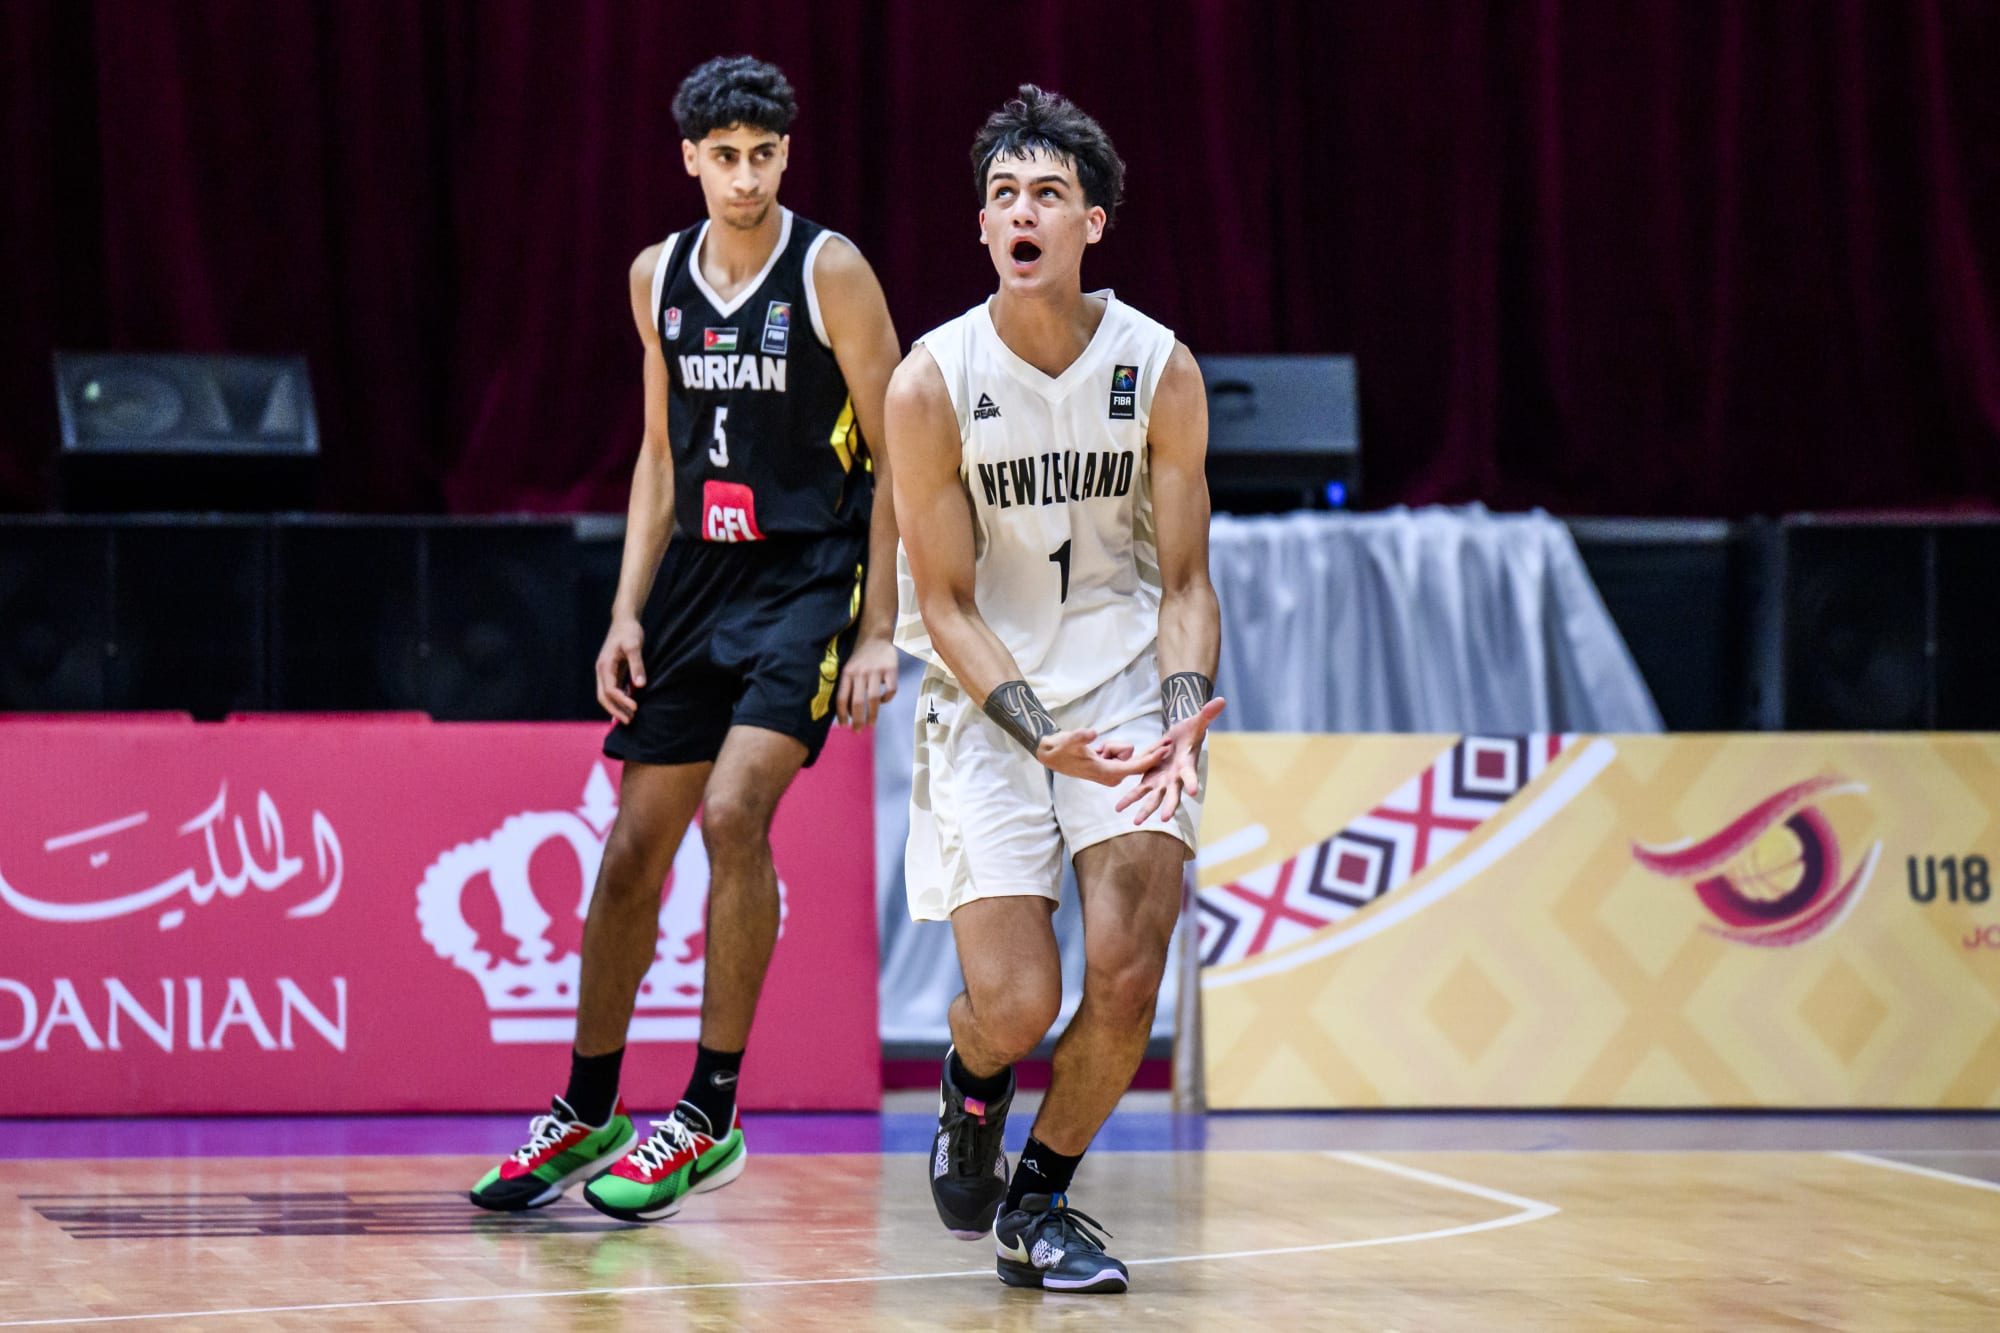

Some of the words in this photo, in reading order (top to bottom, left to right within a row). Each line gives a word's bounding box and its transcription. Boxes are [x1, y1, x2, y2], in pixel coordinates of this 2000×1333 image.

[974, 406, 1002, 420] PEAK
[1113, 396, 1132, 406] FIBA
[709, 406, 728, 468] 5
[978, 456, 1035, 509] NEW
[1049, 538, 1071, 604] 1
[1906, 854, 1991, 904] U18
